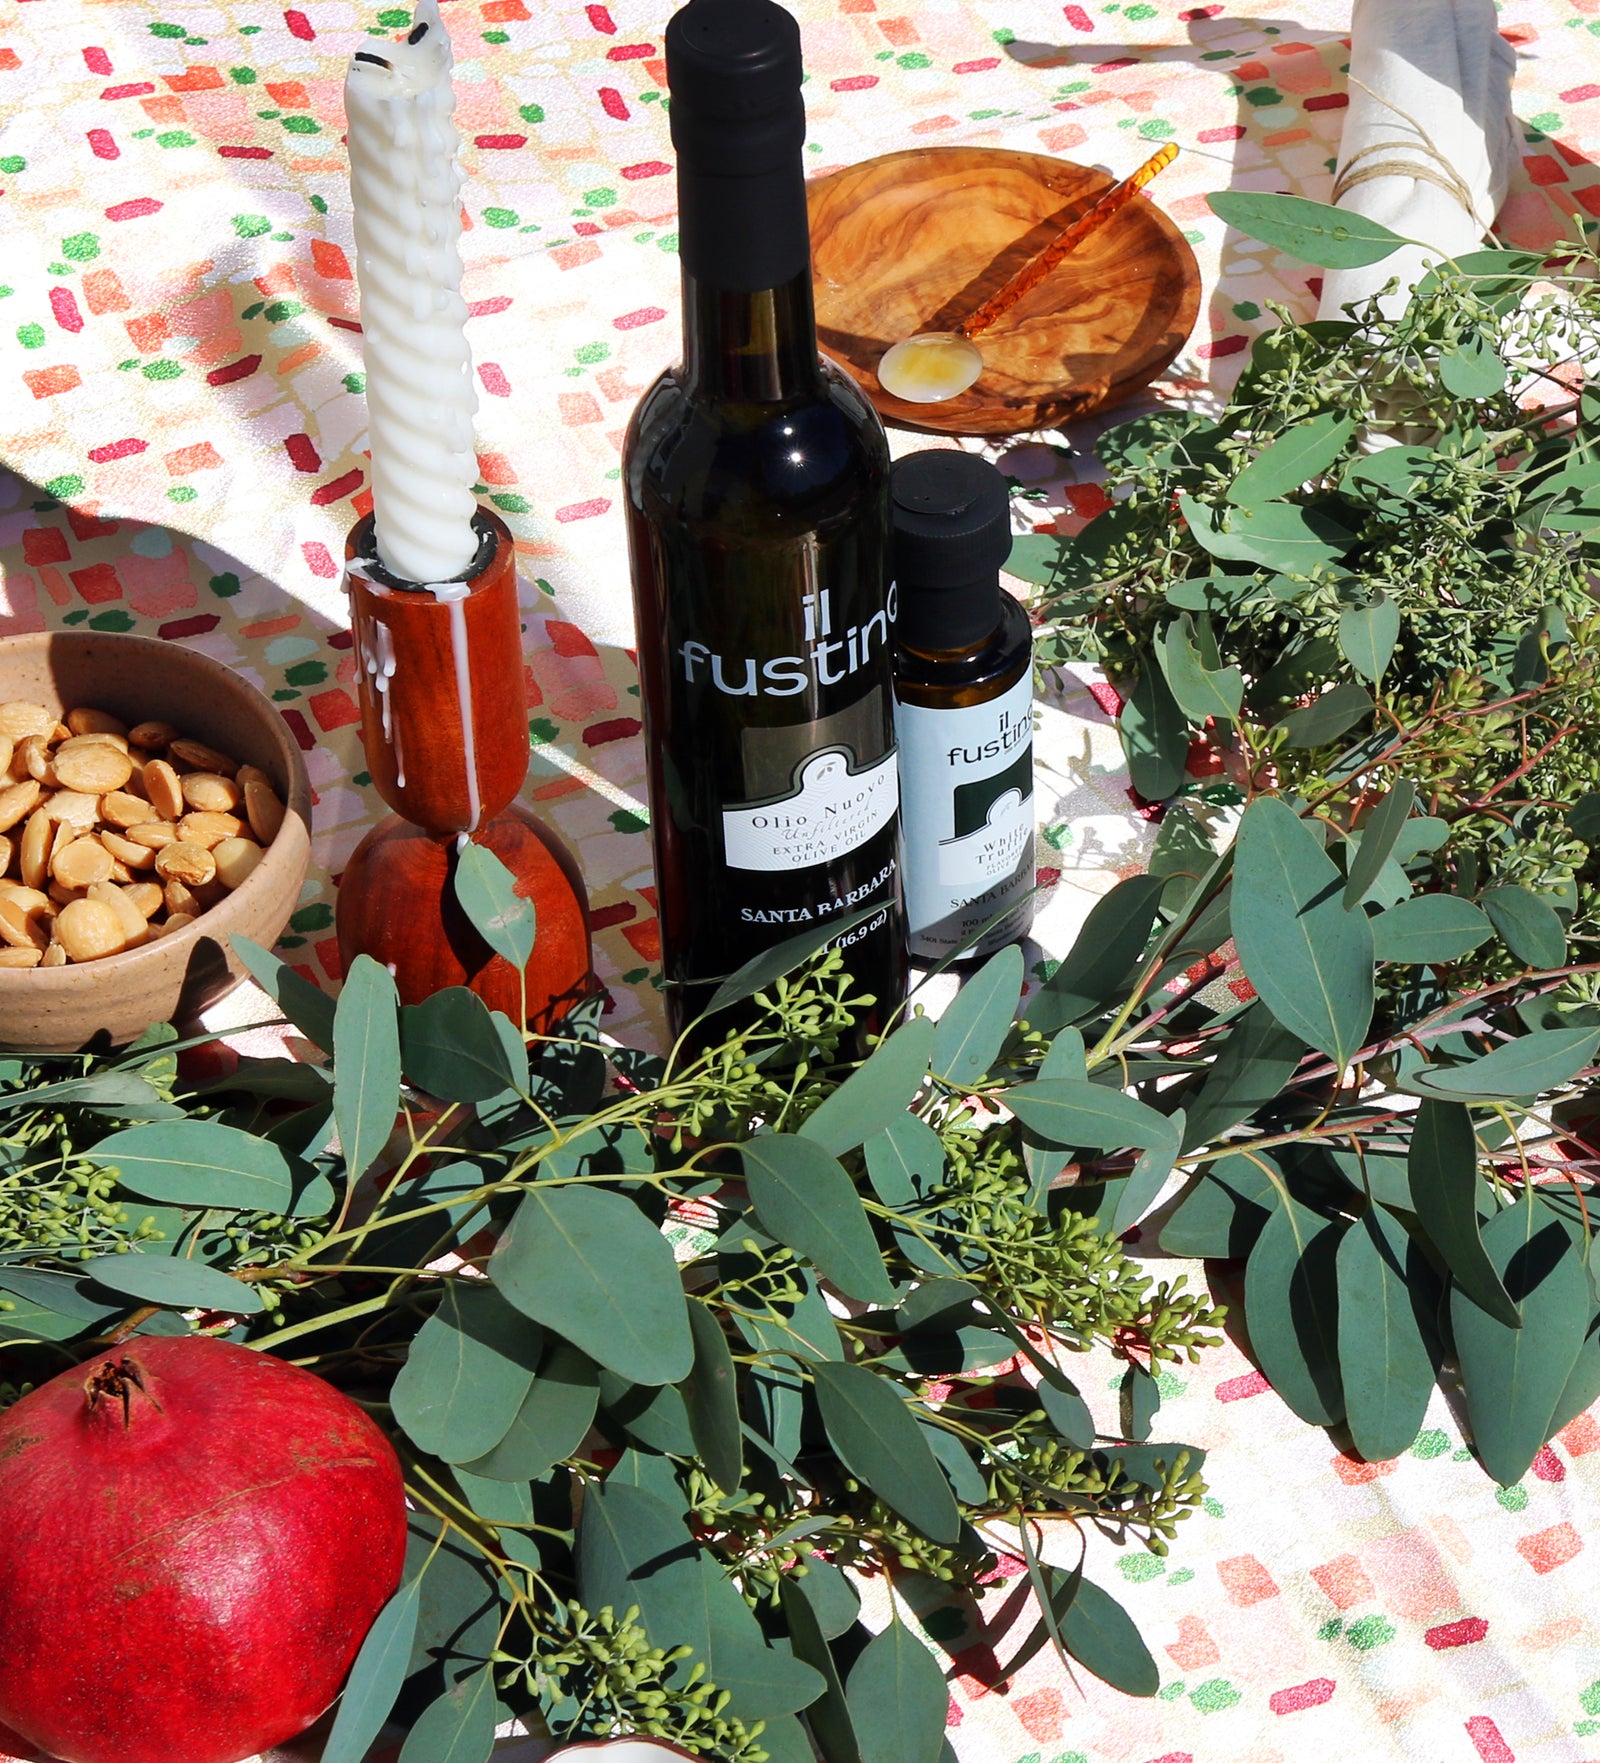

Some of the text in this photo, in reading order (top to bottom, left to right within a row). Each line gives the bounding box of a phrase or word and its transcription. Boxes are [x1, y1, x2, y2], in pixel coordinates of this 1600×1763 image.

[802, 588, 831, 642] il
[678, 580, 898, 697] fustino
[999, 711, 1009, 732] il
[752, 774, 885, 829] Olio Nuovo
[773, 809, 879, 855] EXTRA VIRGIN
[792, 831, 866, 862] OLIVE OIL
[975, 827, 1028, 864] Truffle
[984, 823, 1024, 852] White
[741, 858, 897, 924] SANTA BARBARA
[950, 891, 997, 909] SANTA
